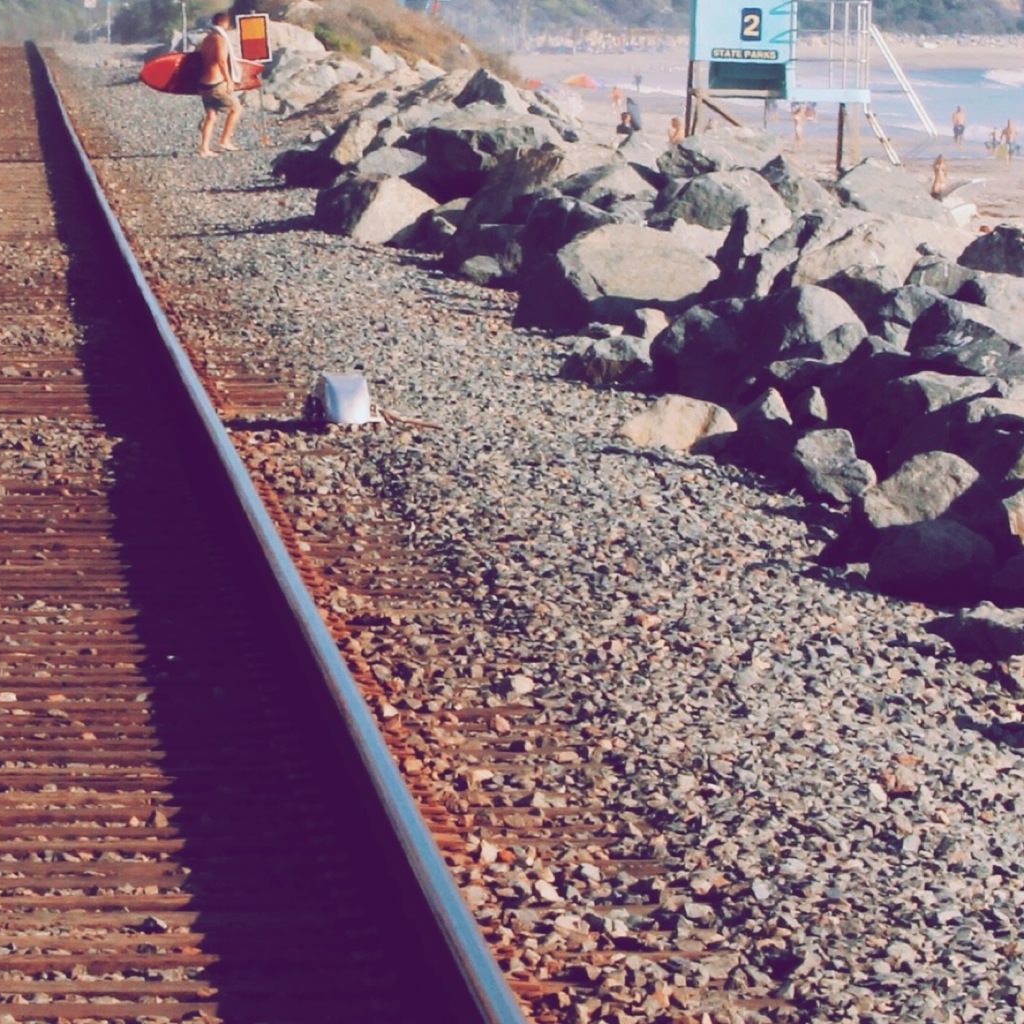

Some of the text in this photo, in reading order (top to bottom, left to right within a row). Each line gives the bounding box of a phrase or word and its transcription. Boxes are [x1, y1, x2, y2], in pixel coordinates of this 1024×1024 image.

[743, 14, 760, 36] 2
[713, 49, 776, 60] STATE PARKS
